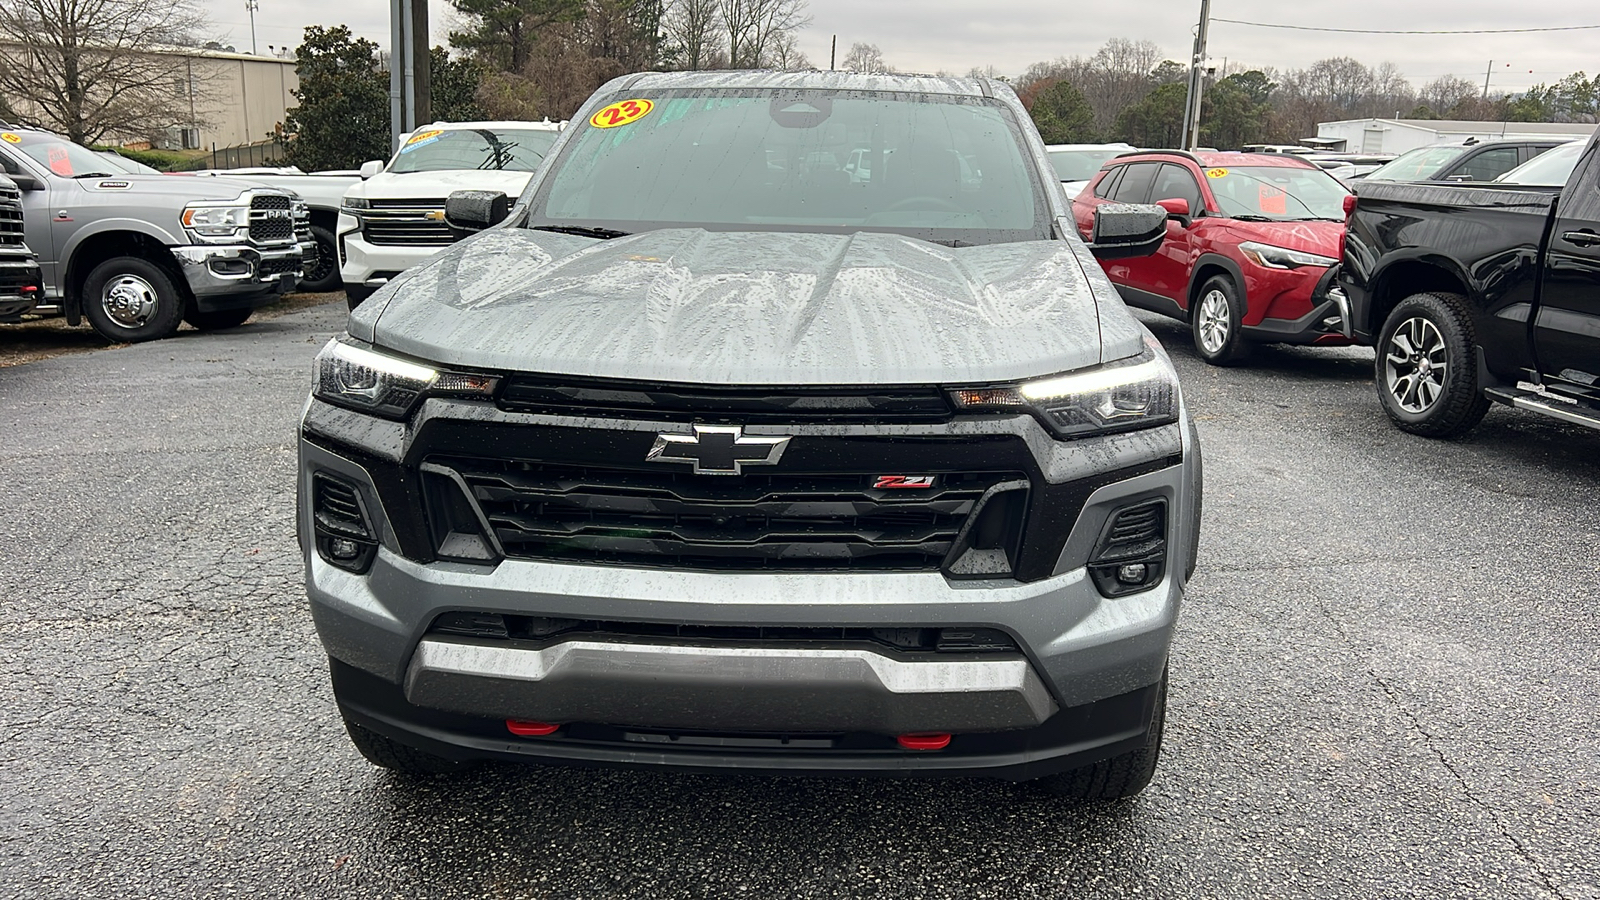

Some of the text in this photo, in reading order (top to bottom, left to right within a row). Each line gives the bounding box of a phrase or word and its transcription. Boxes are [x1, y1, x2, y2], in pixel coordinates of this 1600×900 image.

[601, 100, 642, 126] 23
[50, 149, 67, 164] SALE
[1210, 168, 1225, 178] 23
[266, 209, 290, 219] RAM
